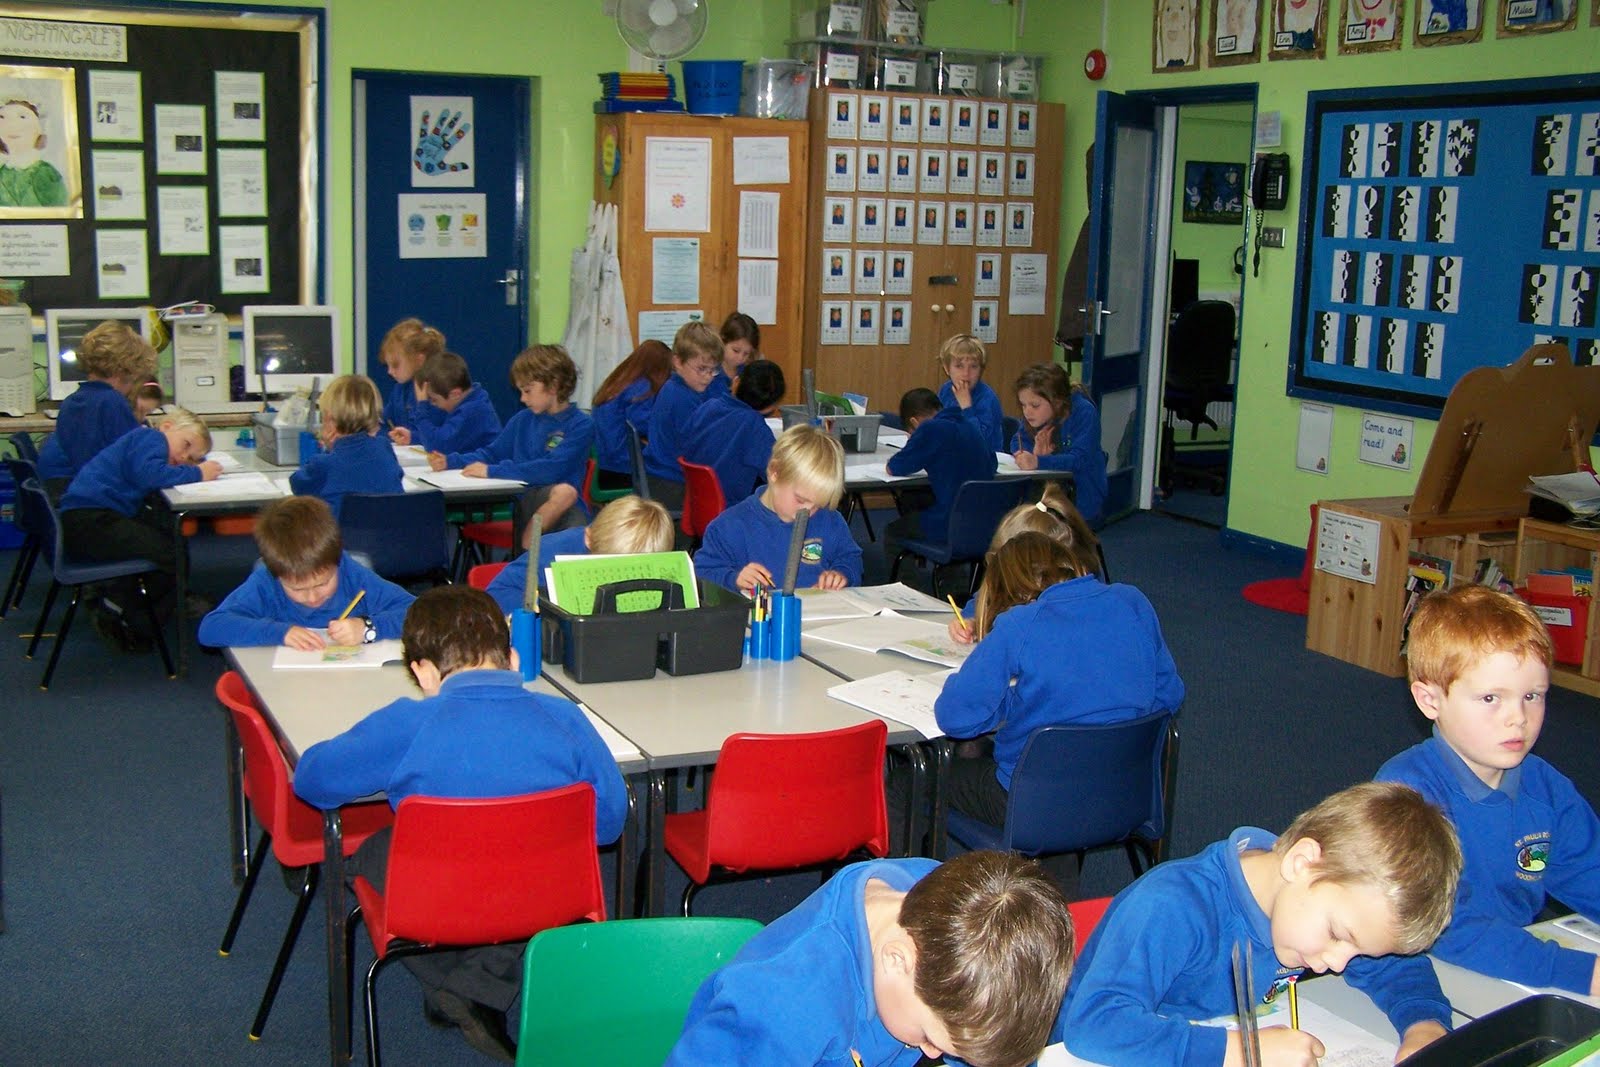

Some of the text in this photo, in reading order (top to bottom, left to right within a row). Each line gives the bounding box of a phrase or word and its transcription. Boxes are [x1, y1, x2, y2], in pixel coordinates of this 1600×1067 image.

[1364, 419, 1403, 437] Come and
[1363, 439, 1385, 449] read!
